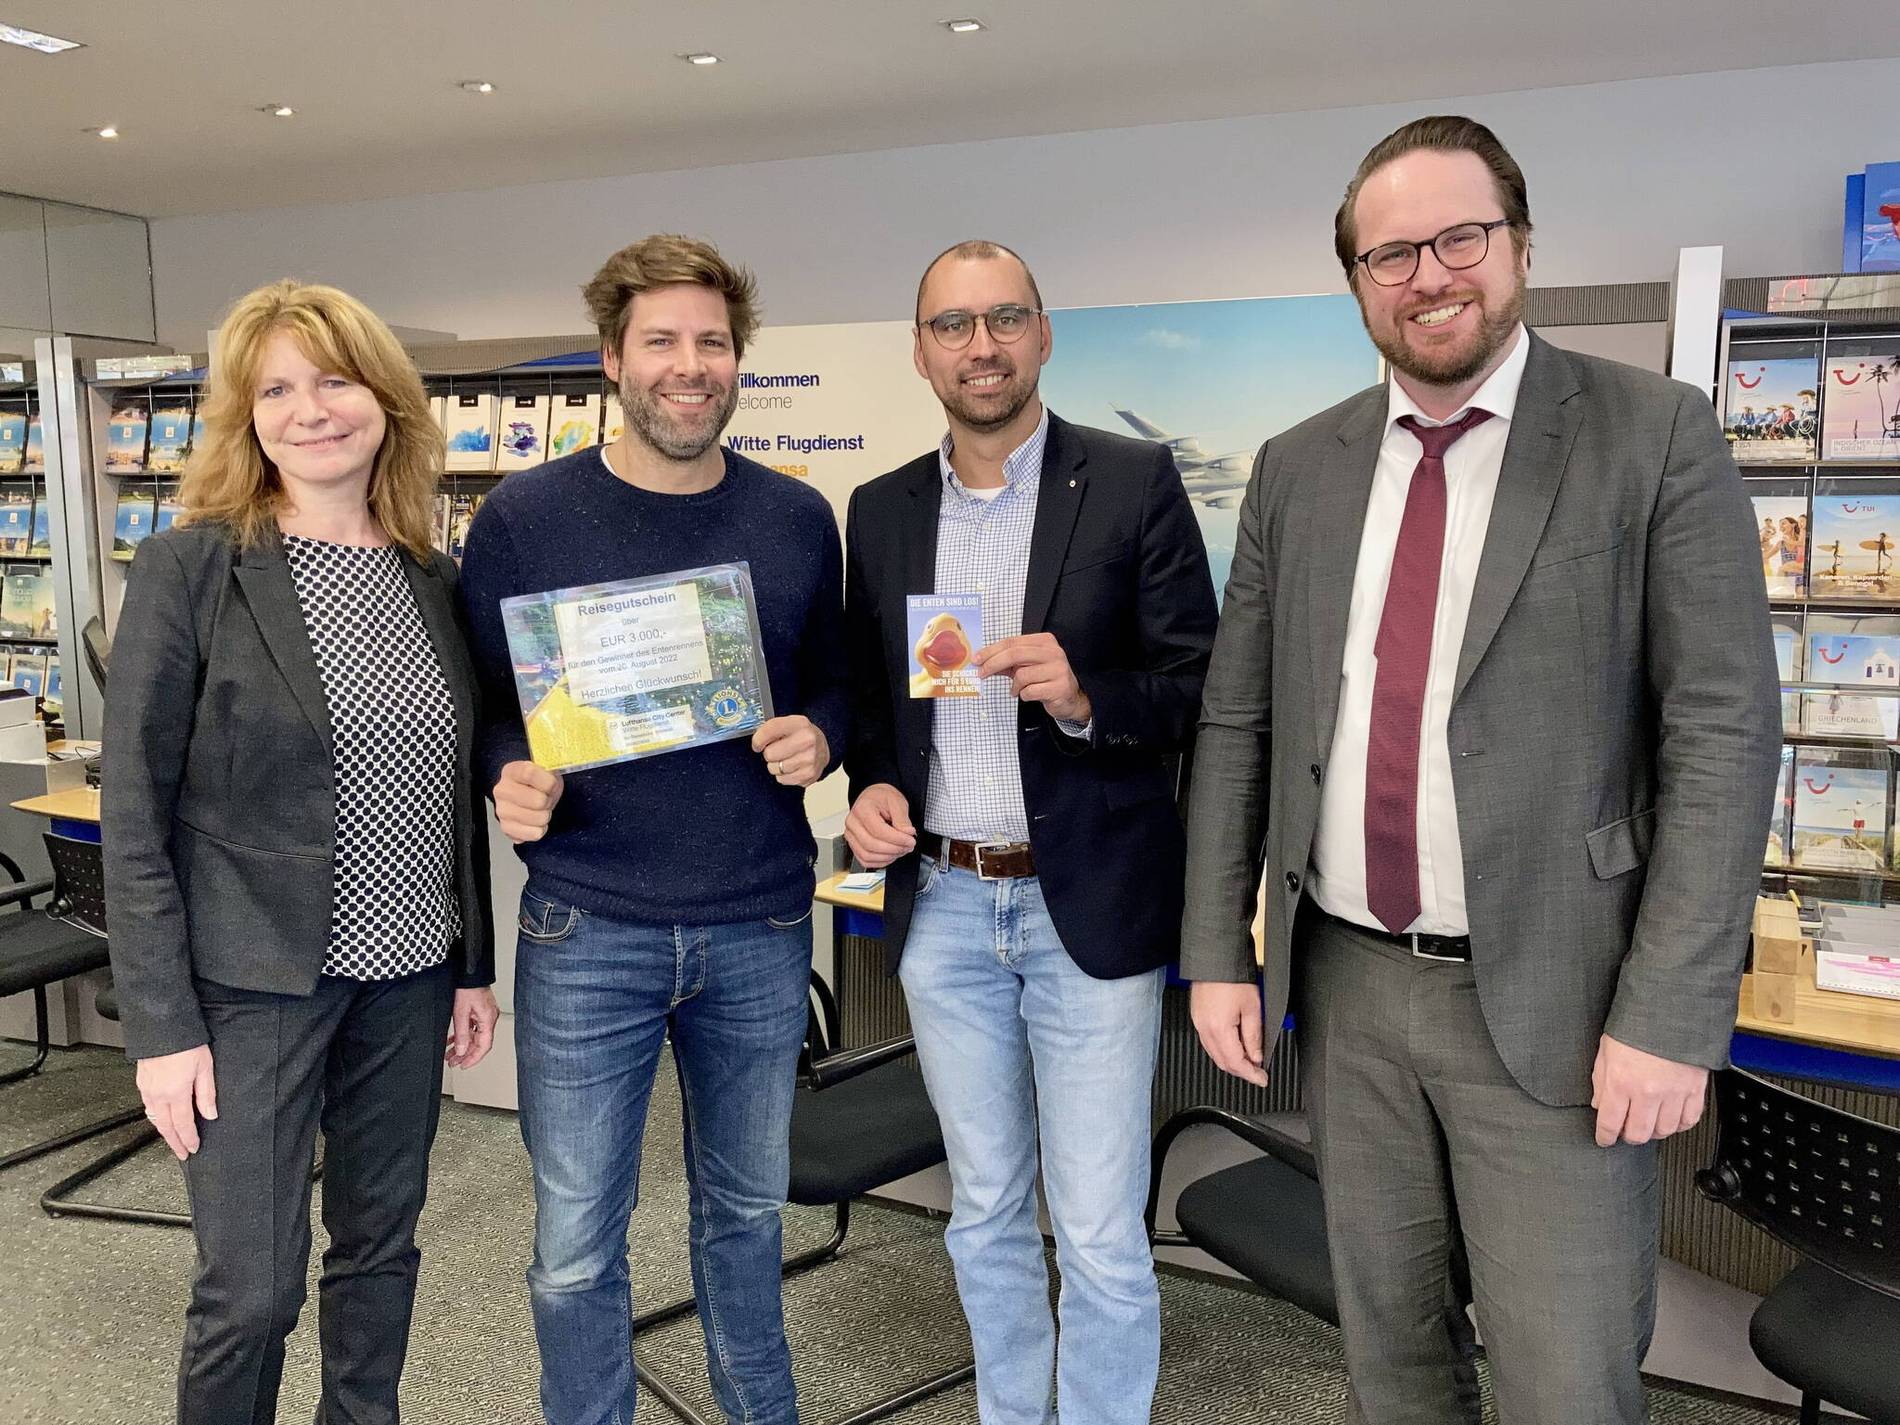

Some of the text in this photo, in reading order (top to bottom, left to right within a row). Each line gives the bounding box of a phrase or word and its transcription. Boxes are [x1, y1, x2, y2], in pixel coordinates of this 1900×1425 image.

[737, 394, 793, 410] elcome
[727, 435, 864, 454] Witte Flugdienst
[577, 592, 677, 616] Reisegutschein
[922, 597, 945, 607] ENTEN
[945, 597, 963, 607] SIND
[622, 617, 639, 627] über
[600, 628, 668, 649] EUR 3.000,-
[568, 639, 704, 671] für den Gewinner des Entenrennens
[630, 657, 658, 671] August
[658, 653, 679, 666] 2022
[581, 668, 703, 700] Herzlichen Glückwunsch!
[652, 713, 666, 723] City
